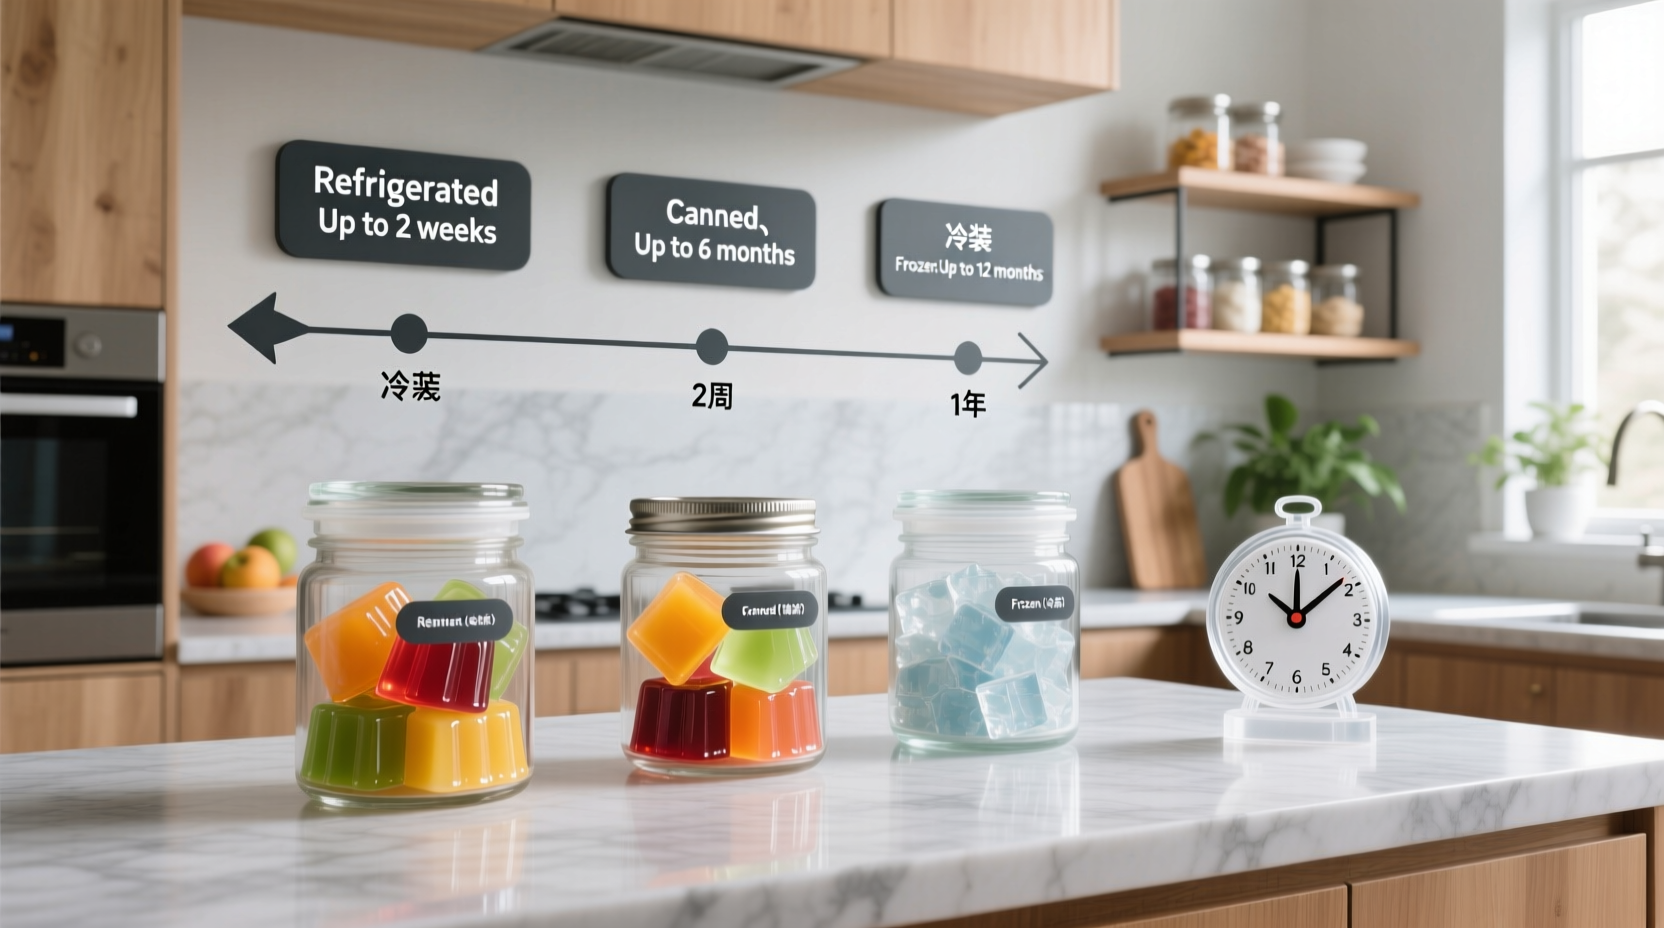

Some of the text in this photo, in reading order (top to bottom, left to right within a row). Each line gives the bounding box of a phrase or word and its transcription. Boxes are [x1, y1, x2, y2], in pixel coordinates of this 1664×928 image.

[314, 165, 499, 208] Refrigerated
[318, 207, 497, 245] Up to 2 weeks
[634, 231, 796, 266] Up to 6 months
[959, 261, 974, 276] to
[976, 262, 991, 278] 12
[993, 264, 1044, 282] months
[691, 381, 733, 411] 2周
[950, 389, 987, 419] 1年
[1265, 561, 1275, 575] 11
[1290, 554, 1306, 568] 12
[1324, 563, 1329, 576] 1
[1243, 582, 1256, 596] 10
[1344, 583, 1354, 597] 2
[1234, 610, 1244, 625] 9
[1352, 613, 1362, 627] 3
[1243, 640, 1253, 655] 8
[1342, 642, 1352, 657] 4
[1265, 661, 1274, 675] 7
[1321, 662, 1331, 676] 5
[1292, 670, 1302, 685] 6
